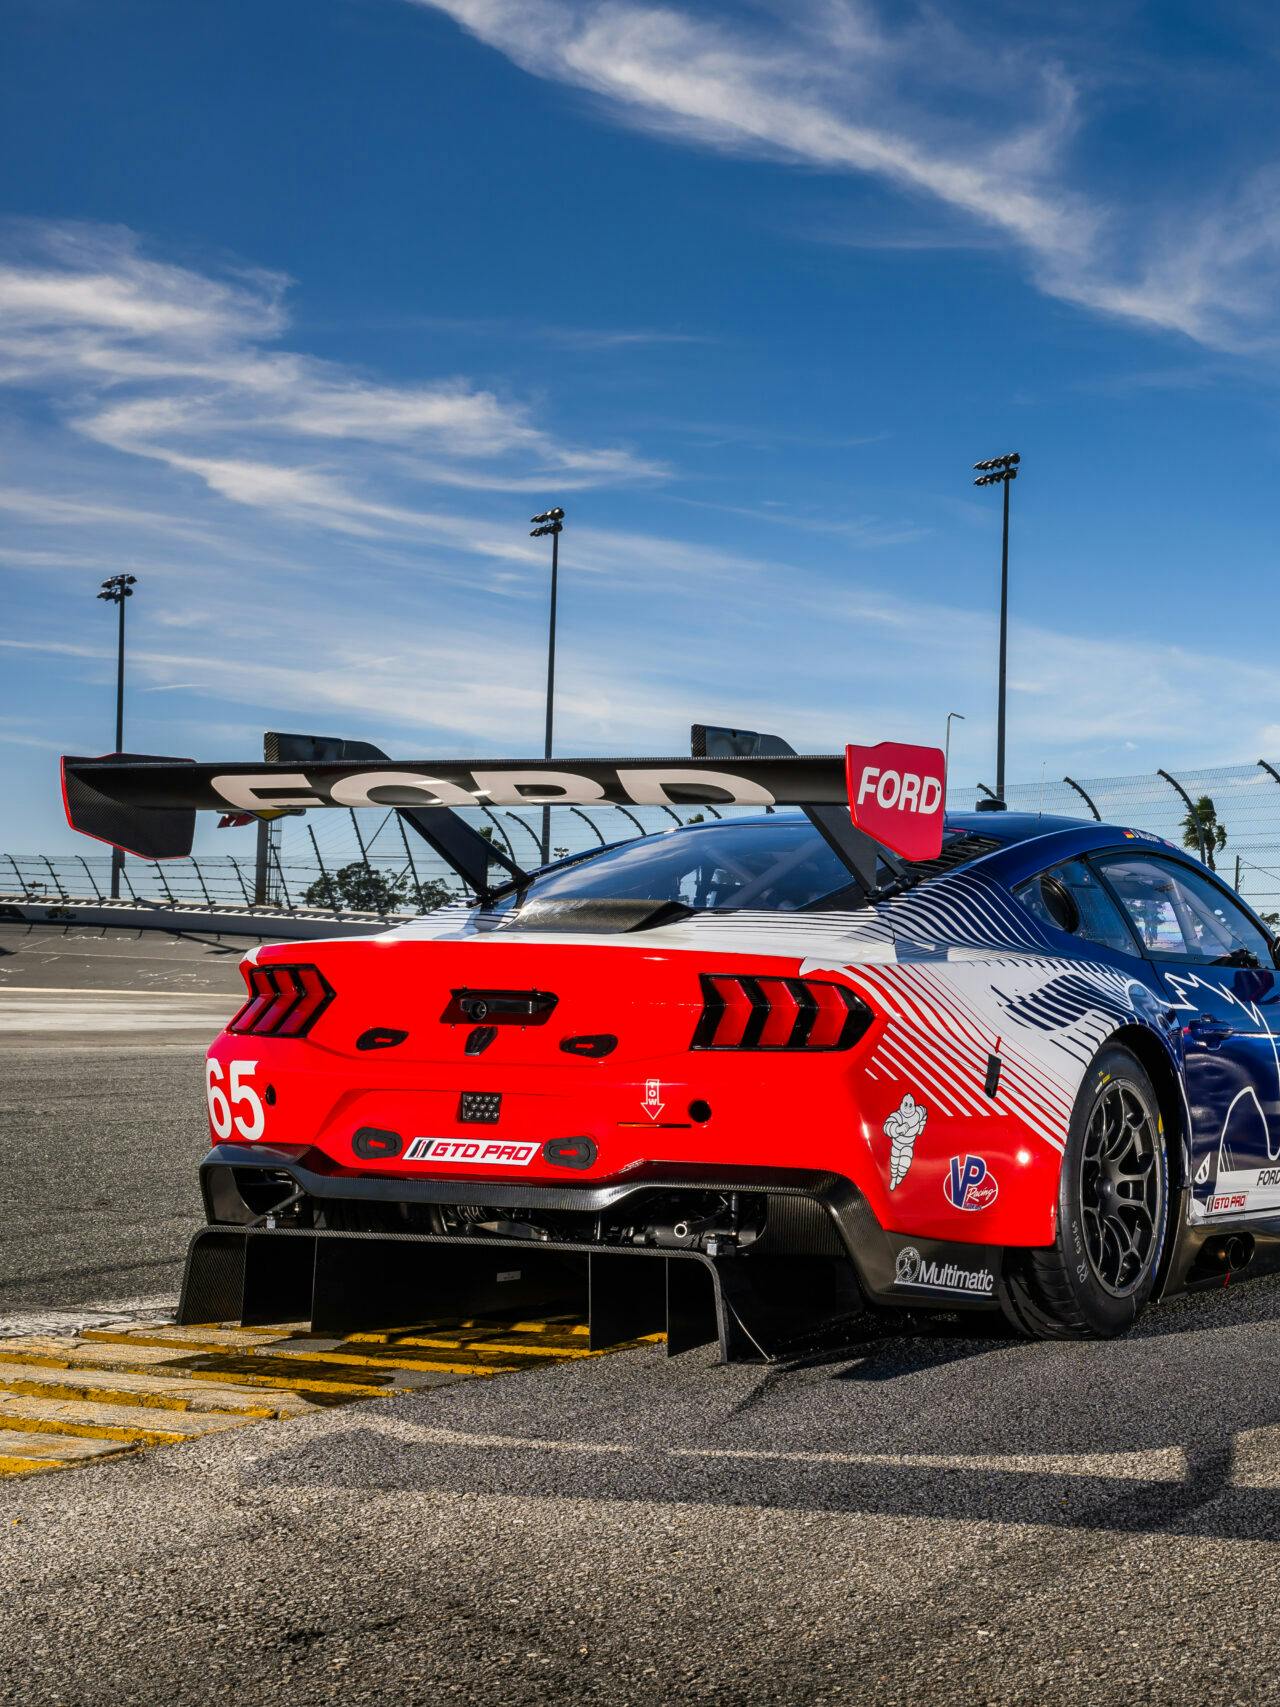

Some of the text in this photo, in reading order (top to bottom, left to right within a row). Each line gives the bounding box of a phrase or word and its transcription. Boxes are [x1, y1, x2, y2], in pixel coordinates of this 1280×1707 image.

[857, 766, 942, 815] FORD
[206, 1057, 265, 1141] 65
[649, 1081, 657, 1106] TOW
[431, 1142, 533, 1160] GTD PRO
[950, 1154, 987, 1209] VP
[966, 1187, 994, 1202] Racing
[1214, 1194, 1246, 1210] GTD PRO
[918, 1261, 994, 1291] Multimatic
